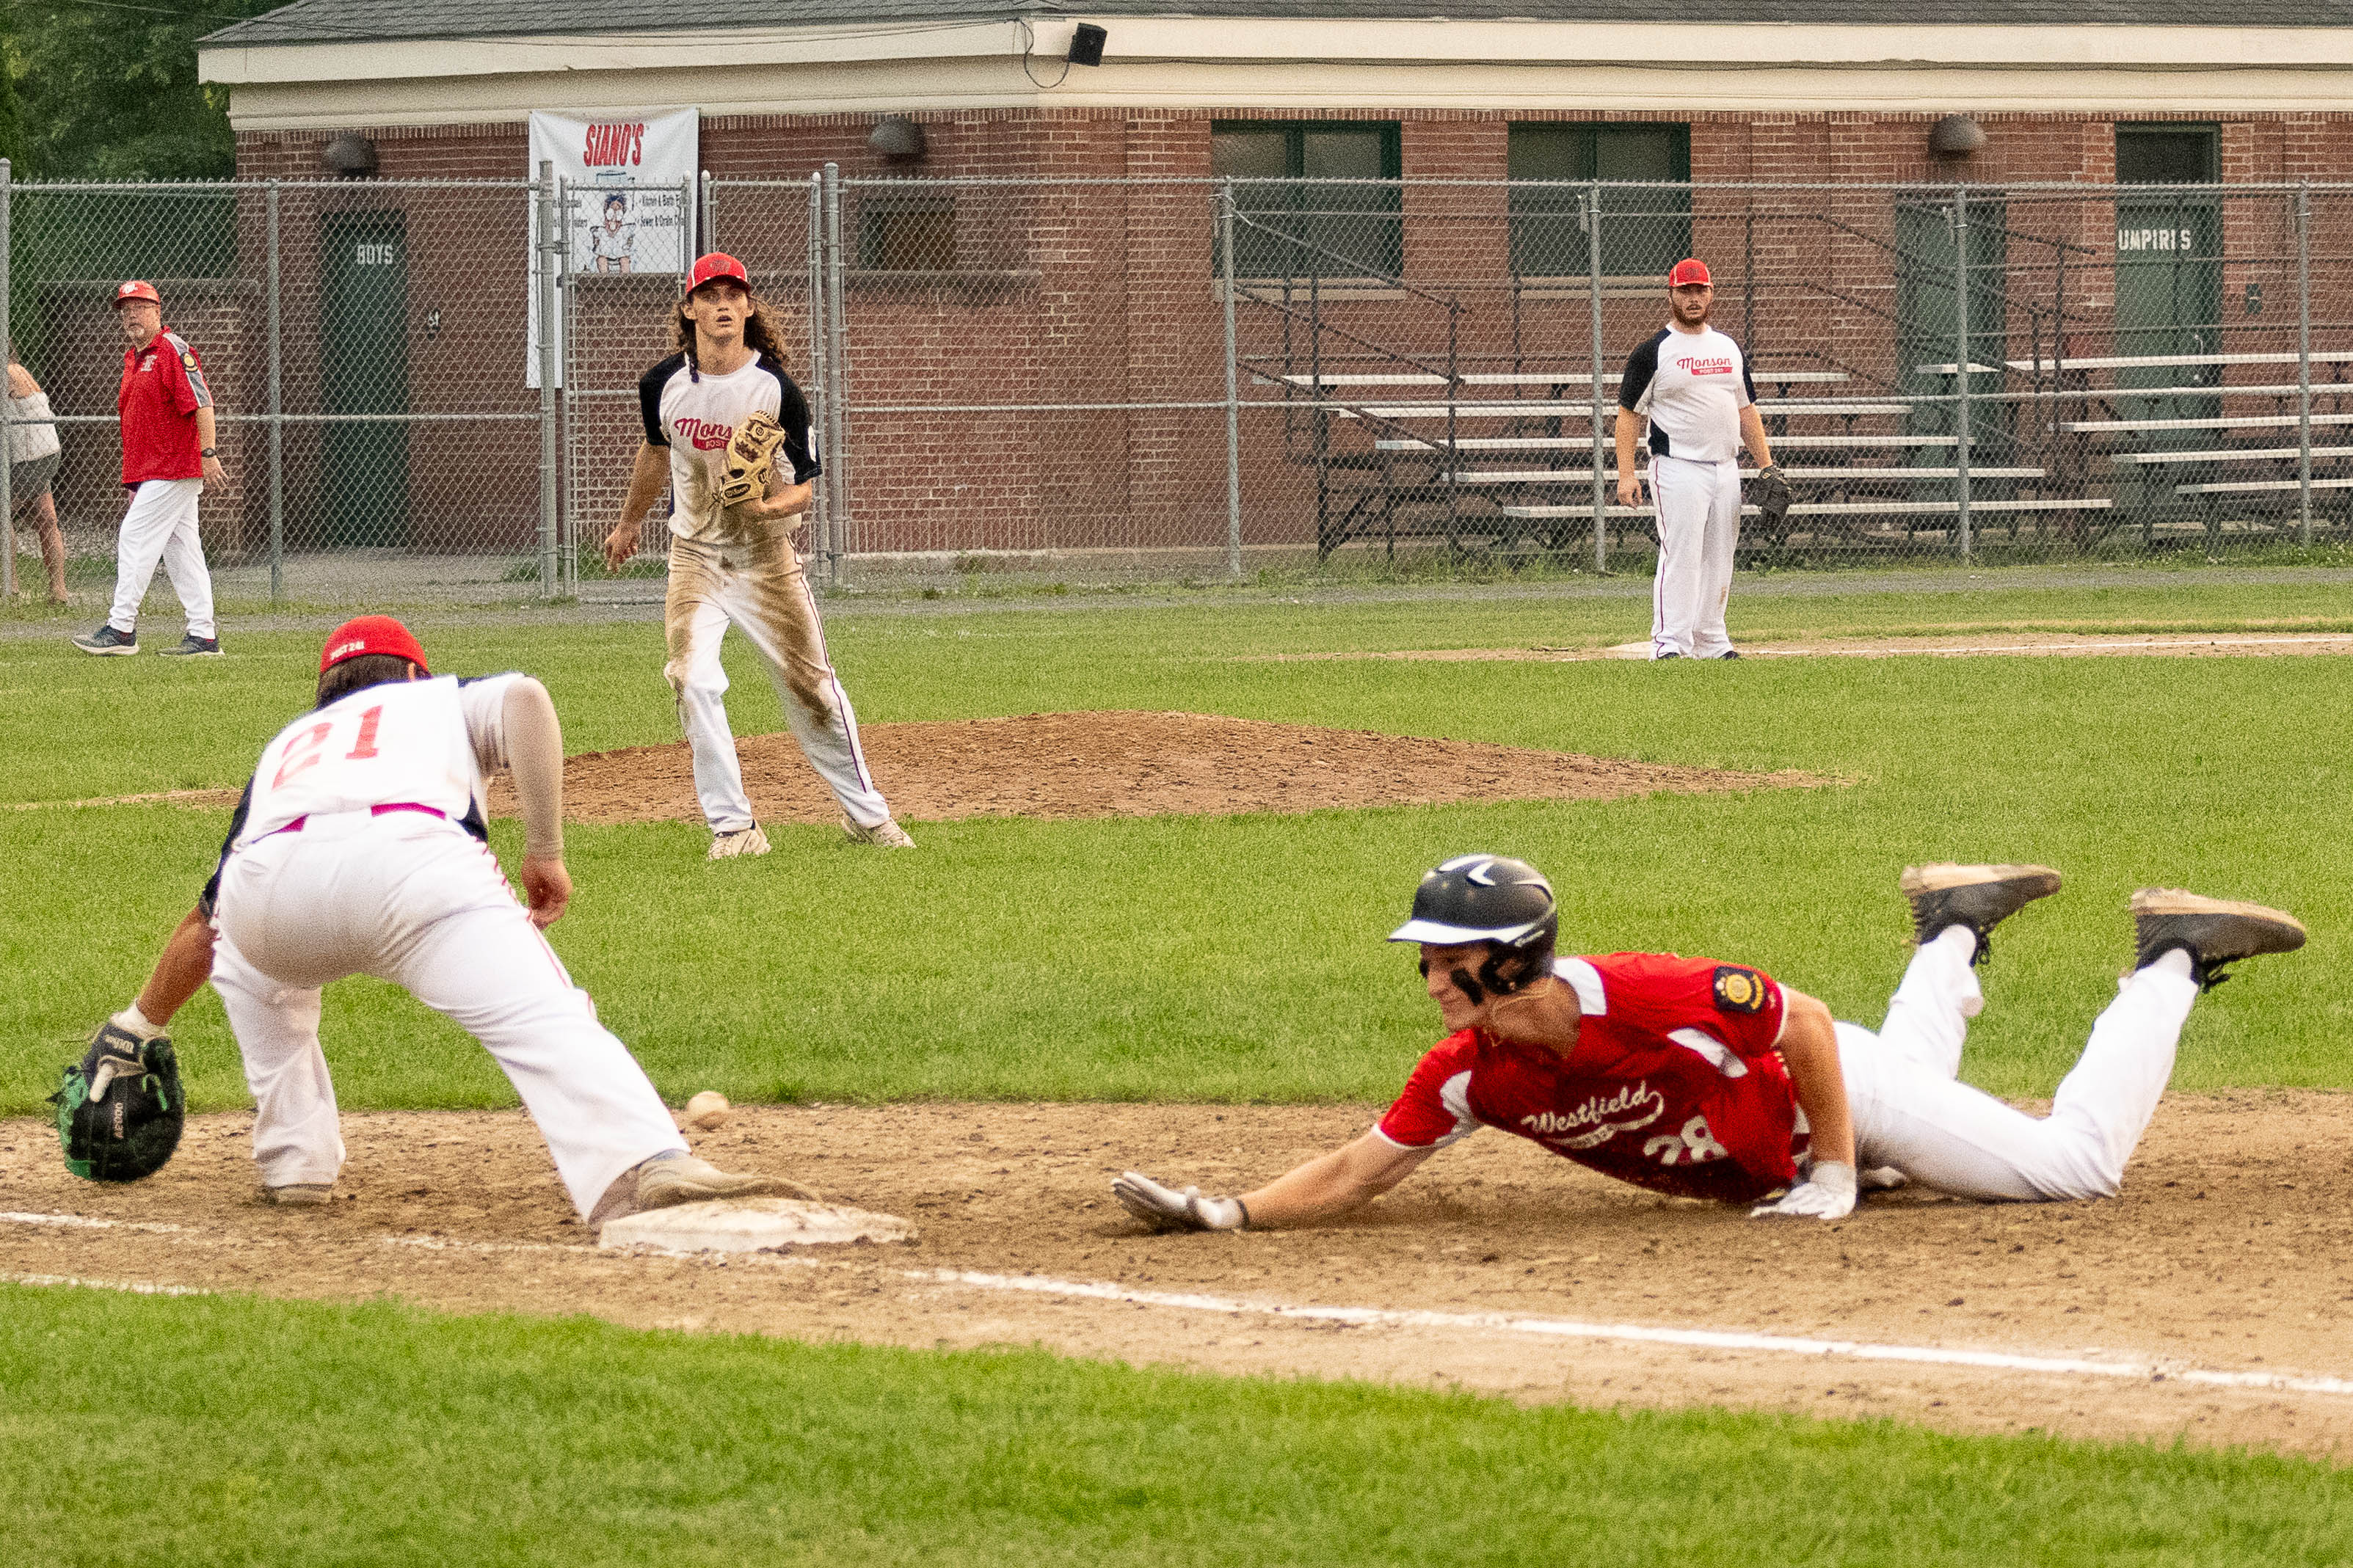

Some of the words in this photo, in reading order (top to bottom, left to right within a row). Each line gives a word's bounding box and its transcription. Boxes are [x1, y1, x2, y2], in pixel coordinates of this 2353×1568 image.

[583, 123, 644, 167] SIANO'S
[357, 244, 393, 265] BOYS
[1677, 357, 1732, 369] Monson
[674, 418, 732, 441] Mons
[705, 440, 726, 449] POST
[272, 704, 384, 792] 21
[1520, 1080, 1653, 1134] Westfield
